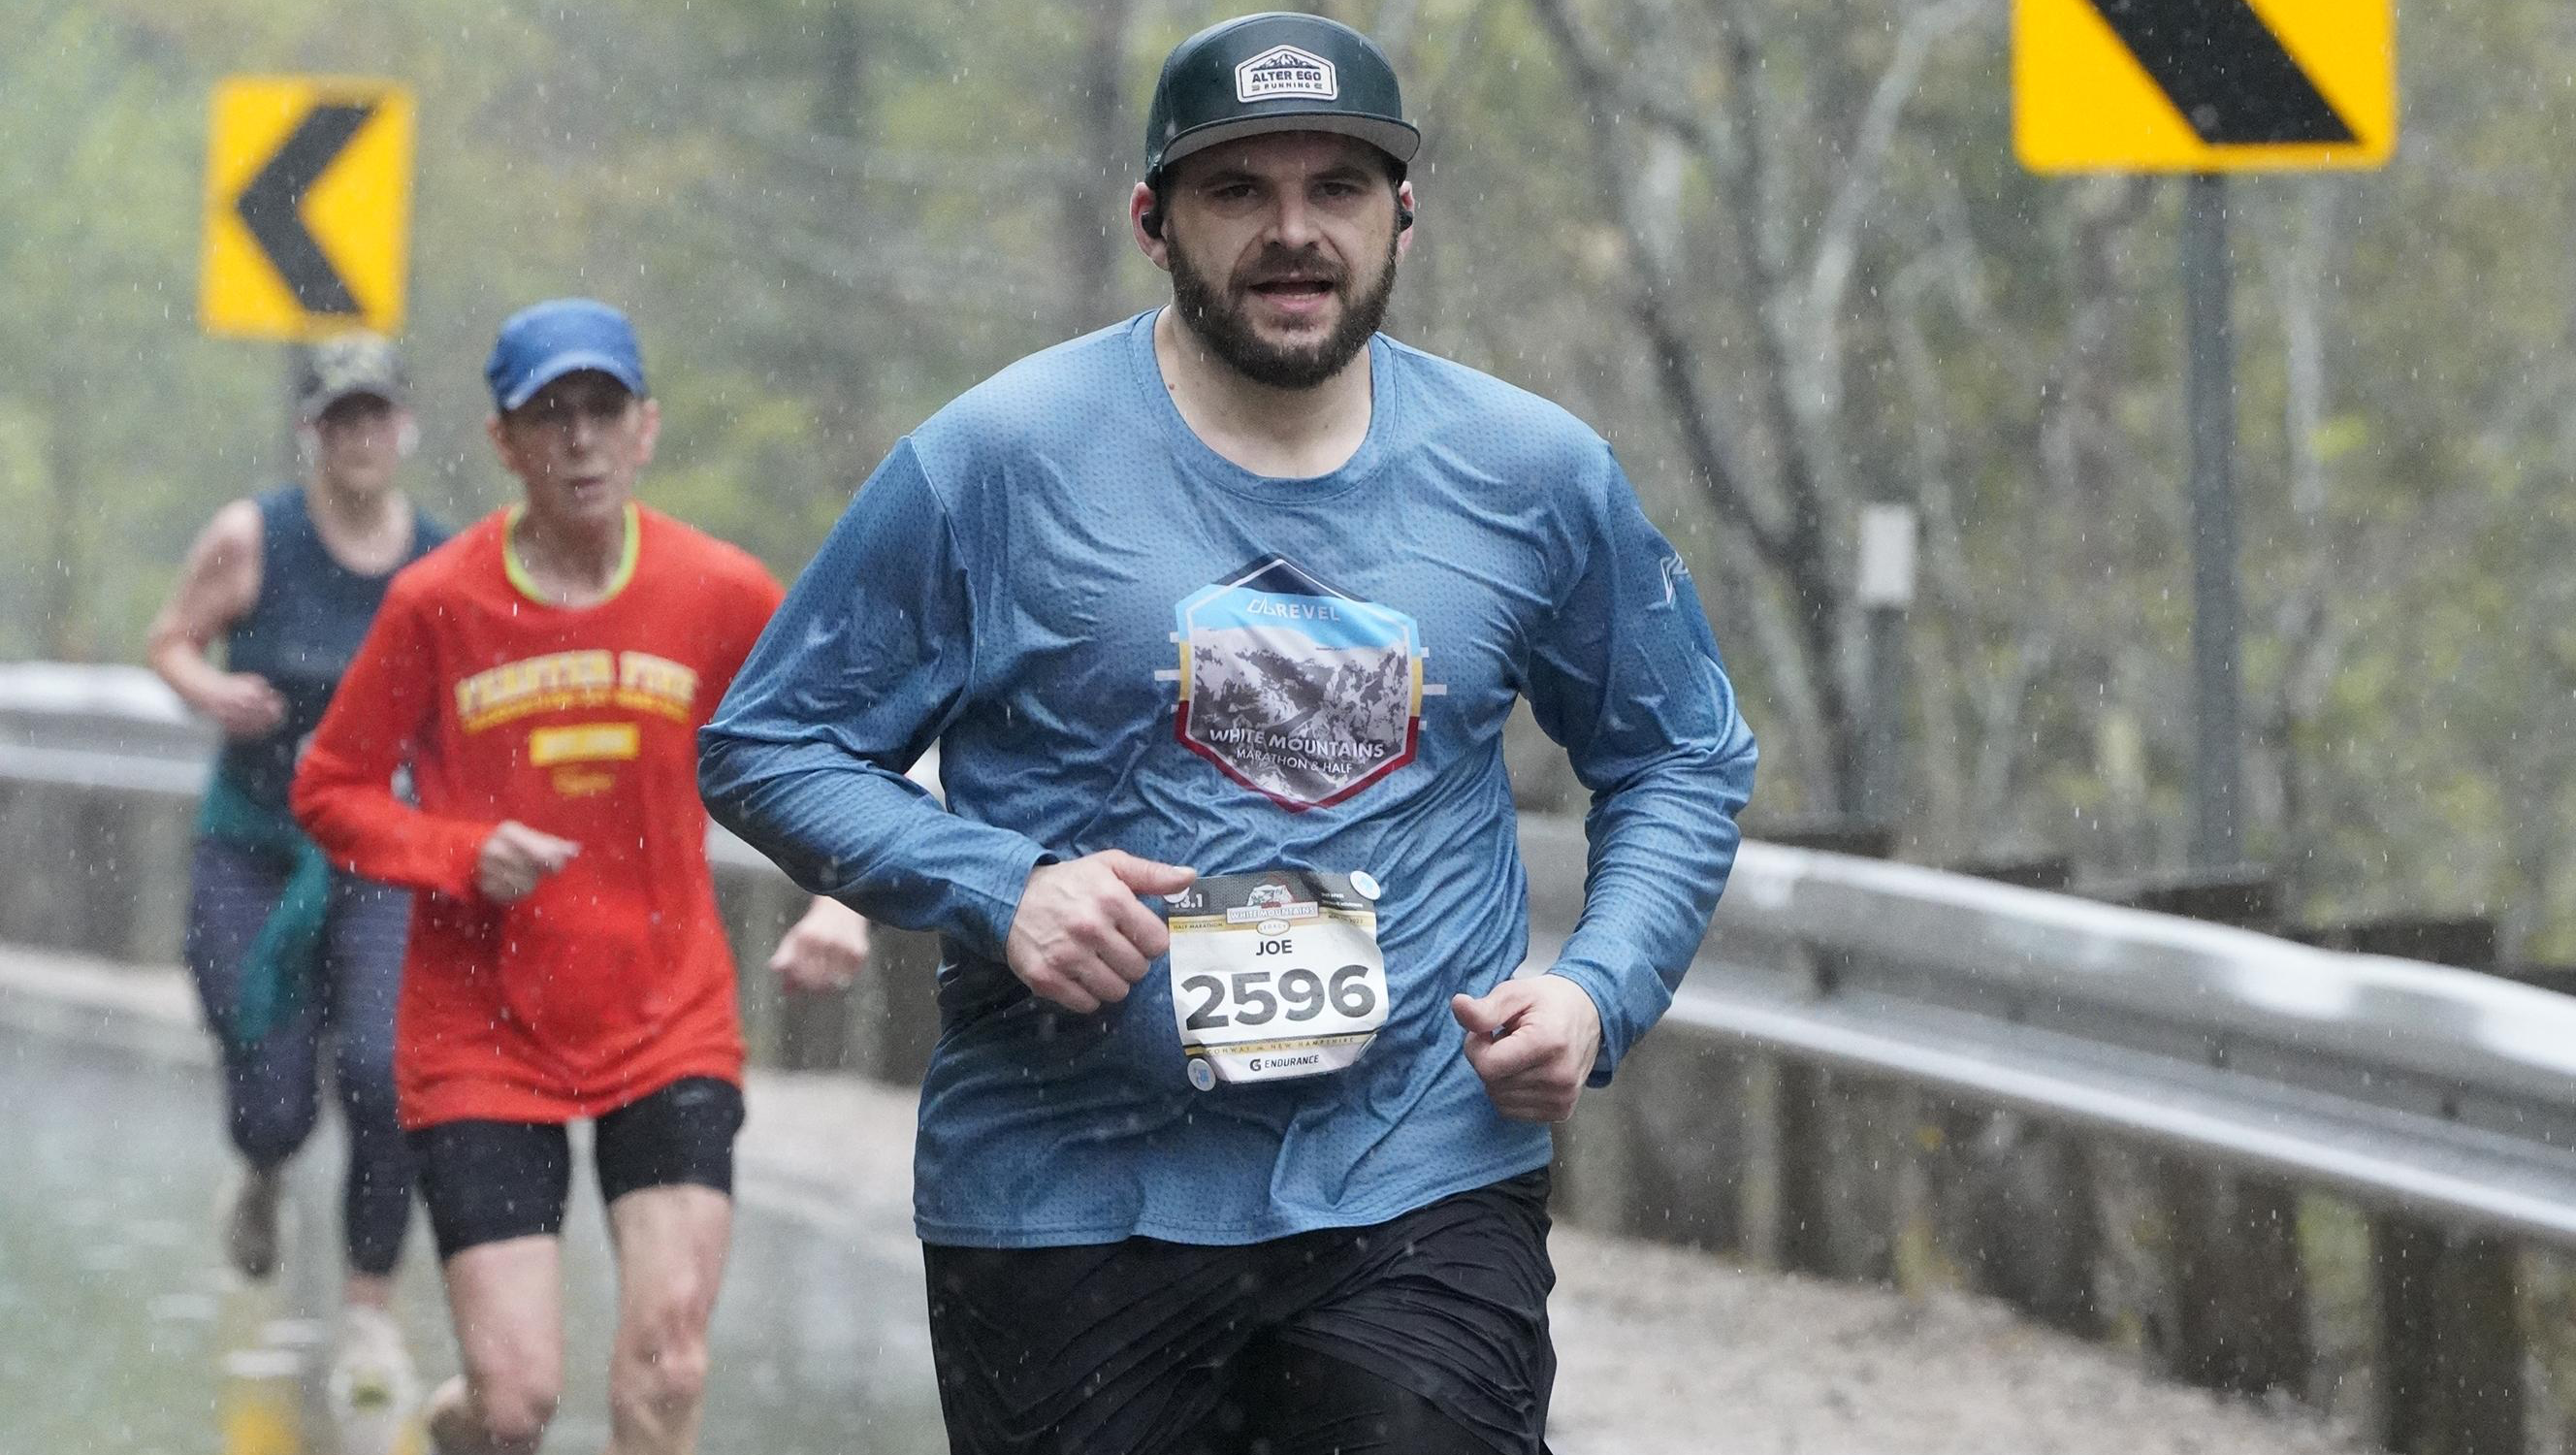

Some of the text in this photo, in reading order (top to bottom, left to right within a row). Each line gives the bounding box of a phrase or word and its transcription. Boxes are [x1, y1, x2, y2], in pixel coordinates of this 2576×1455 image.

[1252, 71, 1322, 82] ALTER EGO
[1276, 603, 1340, 622] REVEL
[1209, 728, 1385, 759] WHITE MOUNTAINS
[1237, 748, 1353, 774] MARATHON & HALF
[1175, 893, 1203, 908] 3.1
[1230, 906, 1315, 920] WHITE MOUNTAINS
[1256, 939, 1293, 955] JOE
[1180, 964, 1376, 1031] 2596
[1265, 1054, 1319, 1068] ENDURANCE
